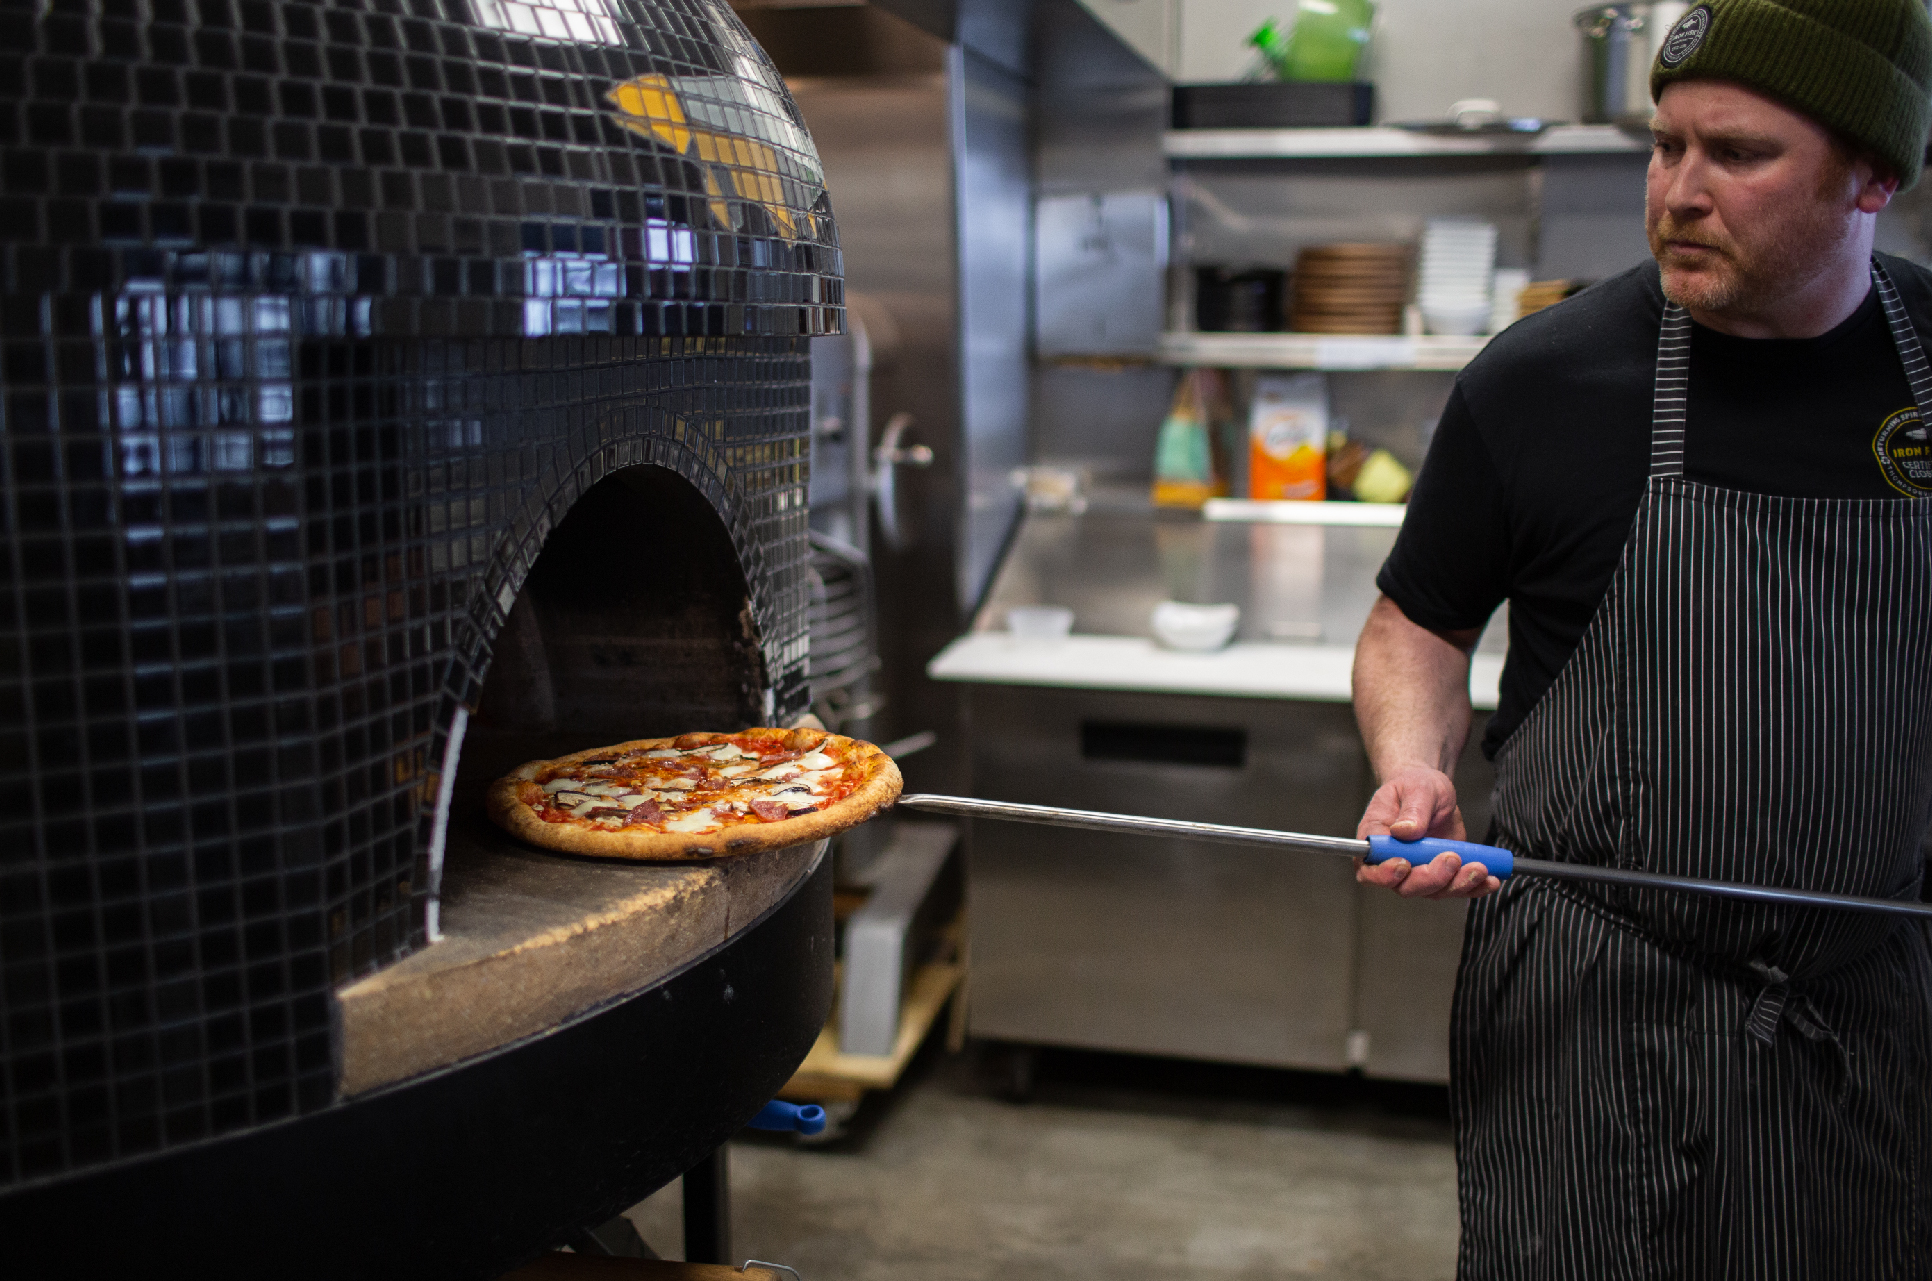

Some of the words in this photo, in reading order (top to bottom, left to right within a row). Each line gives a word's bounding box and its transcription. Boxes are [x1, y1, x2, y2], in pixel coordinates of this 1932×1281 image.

[1900, 411, 1919, 421] SPIR
[1893, 447, 1922, 458] IRON
[1901, 460, 1932, 470] CERTIF
